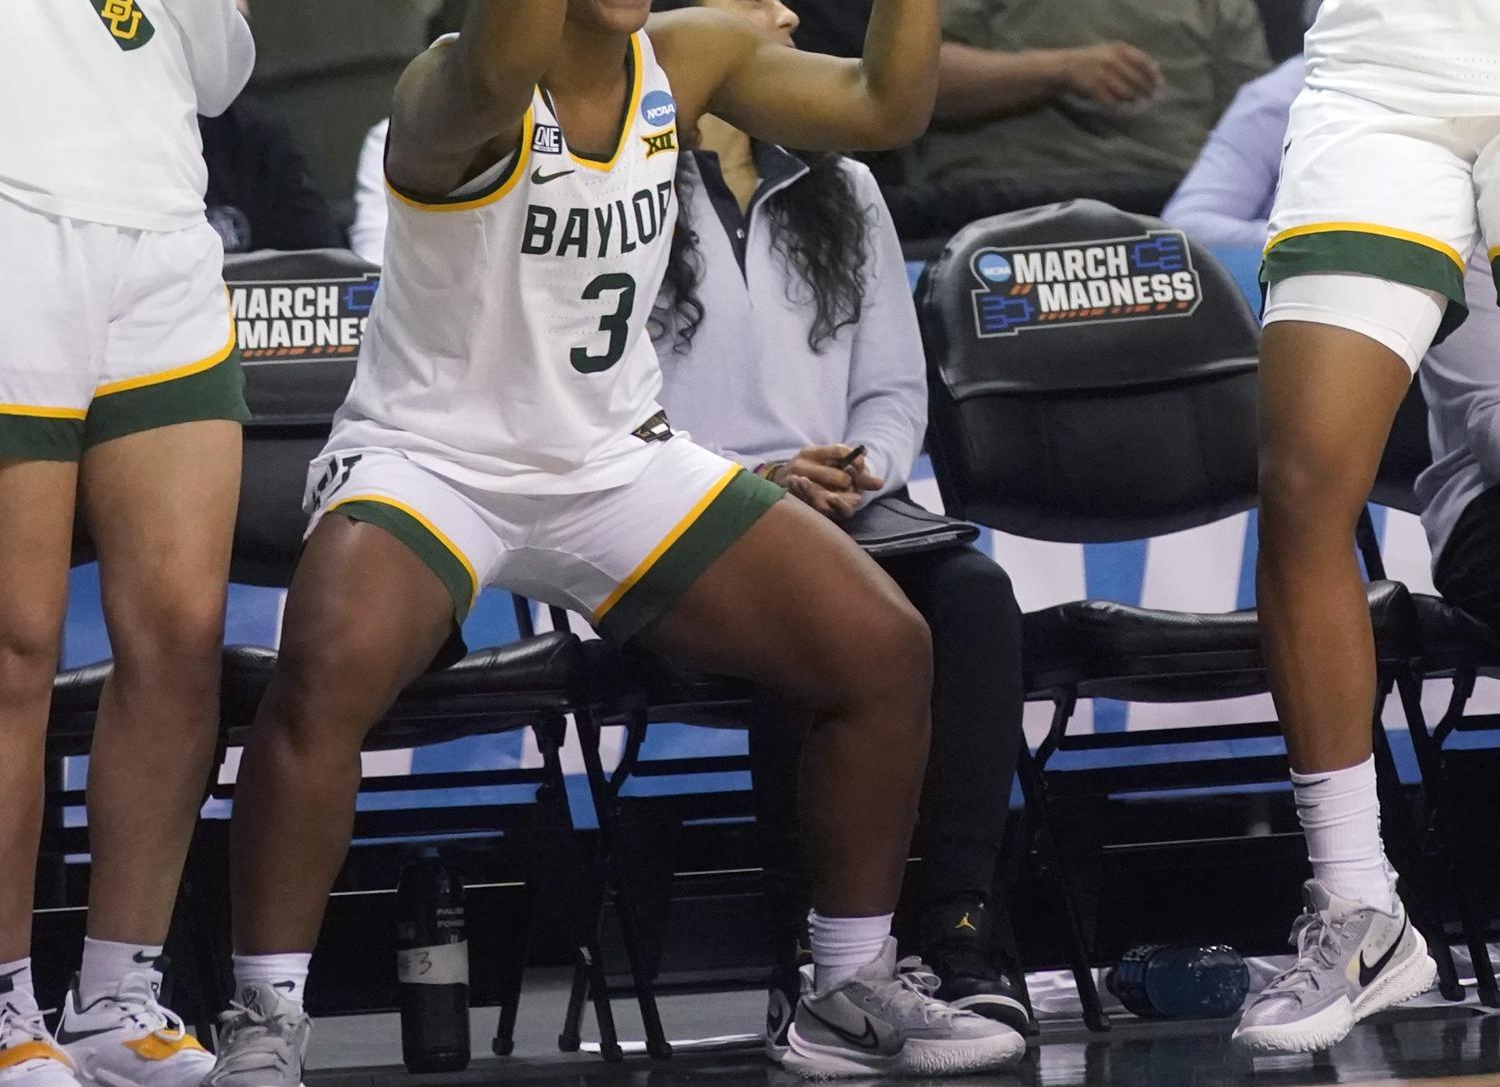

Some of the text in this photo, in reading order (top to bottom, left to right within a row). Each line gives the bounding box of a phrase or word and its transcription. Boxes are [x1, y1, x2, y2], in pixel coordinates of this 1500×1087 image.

[647, 103, 676, 119] NCAA
[535, 126, 560, 145] ONE
[1012, 245, 1130, 285] MARCH
[231, 285, 339, 319] MARCH
[1036, 270, 1196, 313] MADNESS
[570, 272, 637, 375] 3
